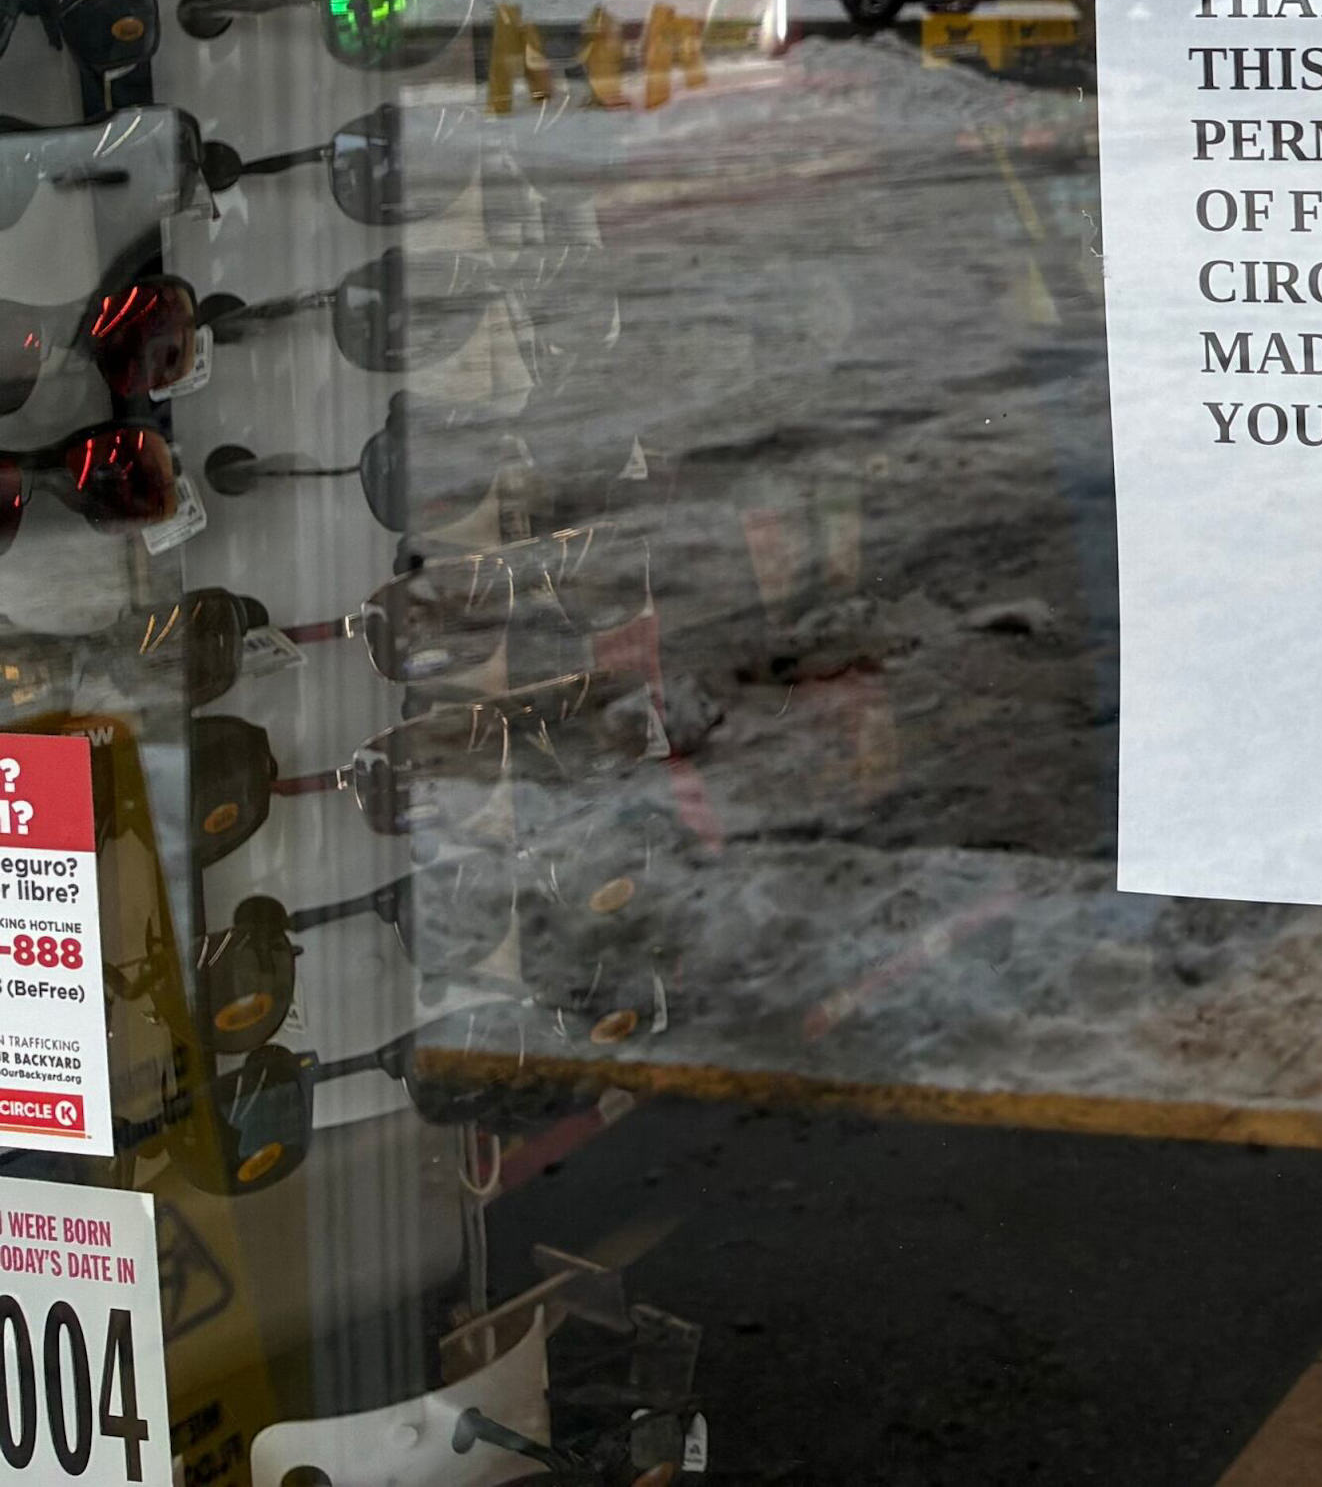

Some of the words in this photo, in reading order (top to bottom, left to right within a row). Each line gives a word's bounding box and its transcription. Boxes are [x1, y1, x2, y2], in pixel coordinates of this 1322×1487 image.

[1195, 189, 1274, 233] OF
[17, 879, 80, 904] libre?
[29, 919, 82, 934] HOTLINE
[7, 979, 85, 1004] (BeFree)
[9, 1035, 81, 1053] TRAFFICKING
[15, 1053, 81, 1070] BACKYARD
[0, 1099, 53, 1120] CIRCLE
[8, 1210, 58, 1243] WERE
[63, 1216, 112, 1248] BORN
[67, 1251, 113, 1283] DATE
[117, 1256, 136, 1285] IN
